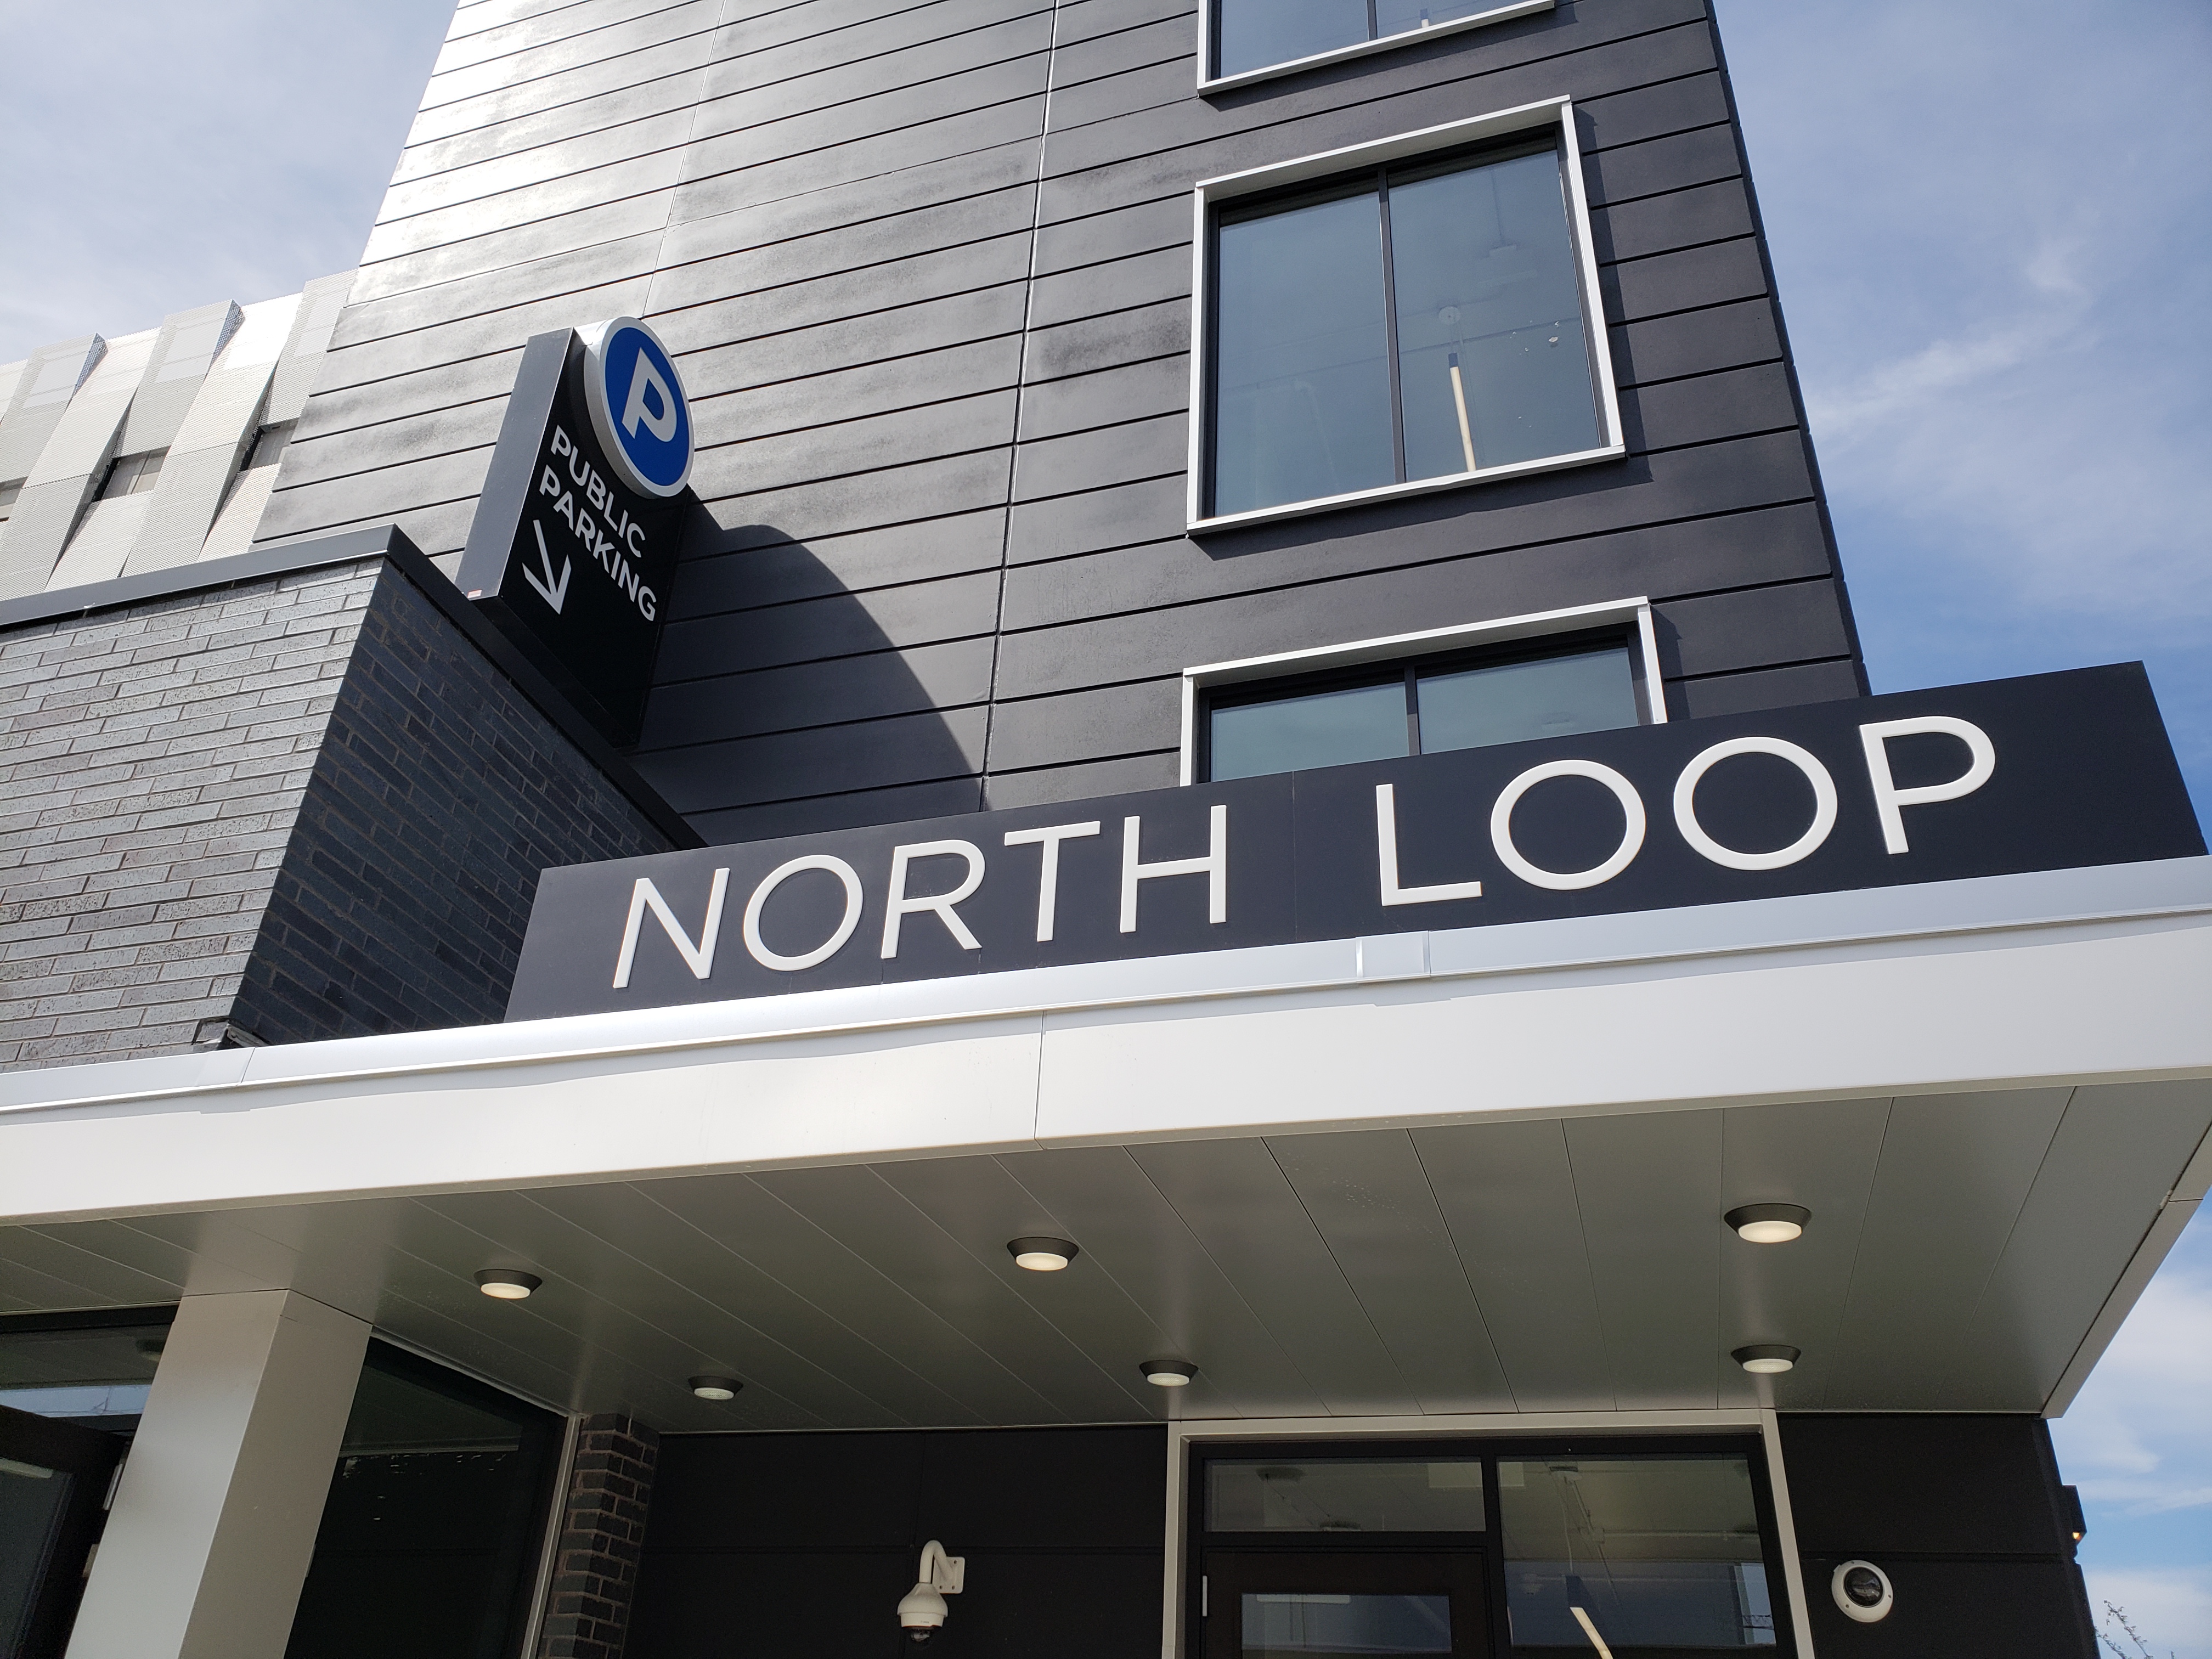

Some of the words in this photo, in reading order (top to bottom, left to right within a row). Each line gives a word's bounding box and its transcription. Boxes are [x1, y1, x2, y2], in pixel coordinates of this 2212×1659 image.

[539, 465, 657, 621] PARKING
[550, 425, 646, 558] PUBLIC
[611, 804, 1228, 990] NORTH
[1375, 715, 1996, 907] LOOP
